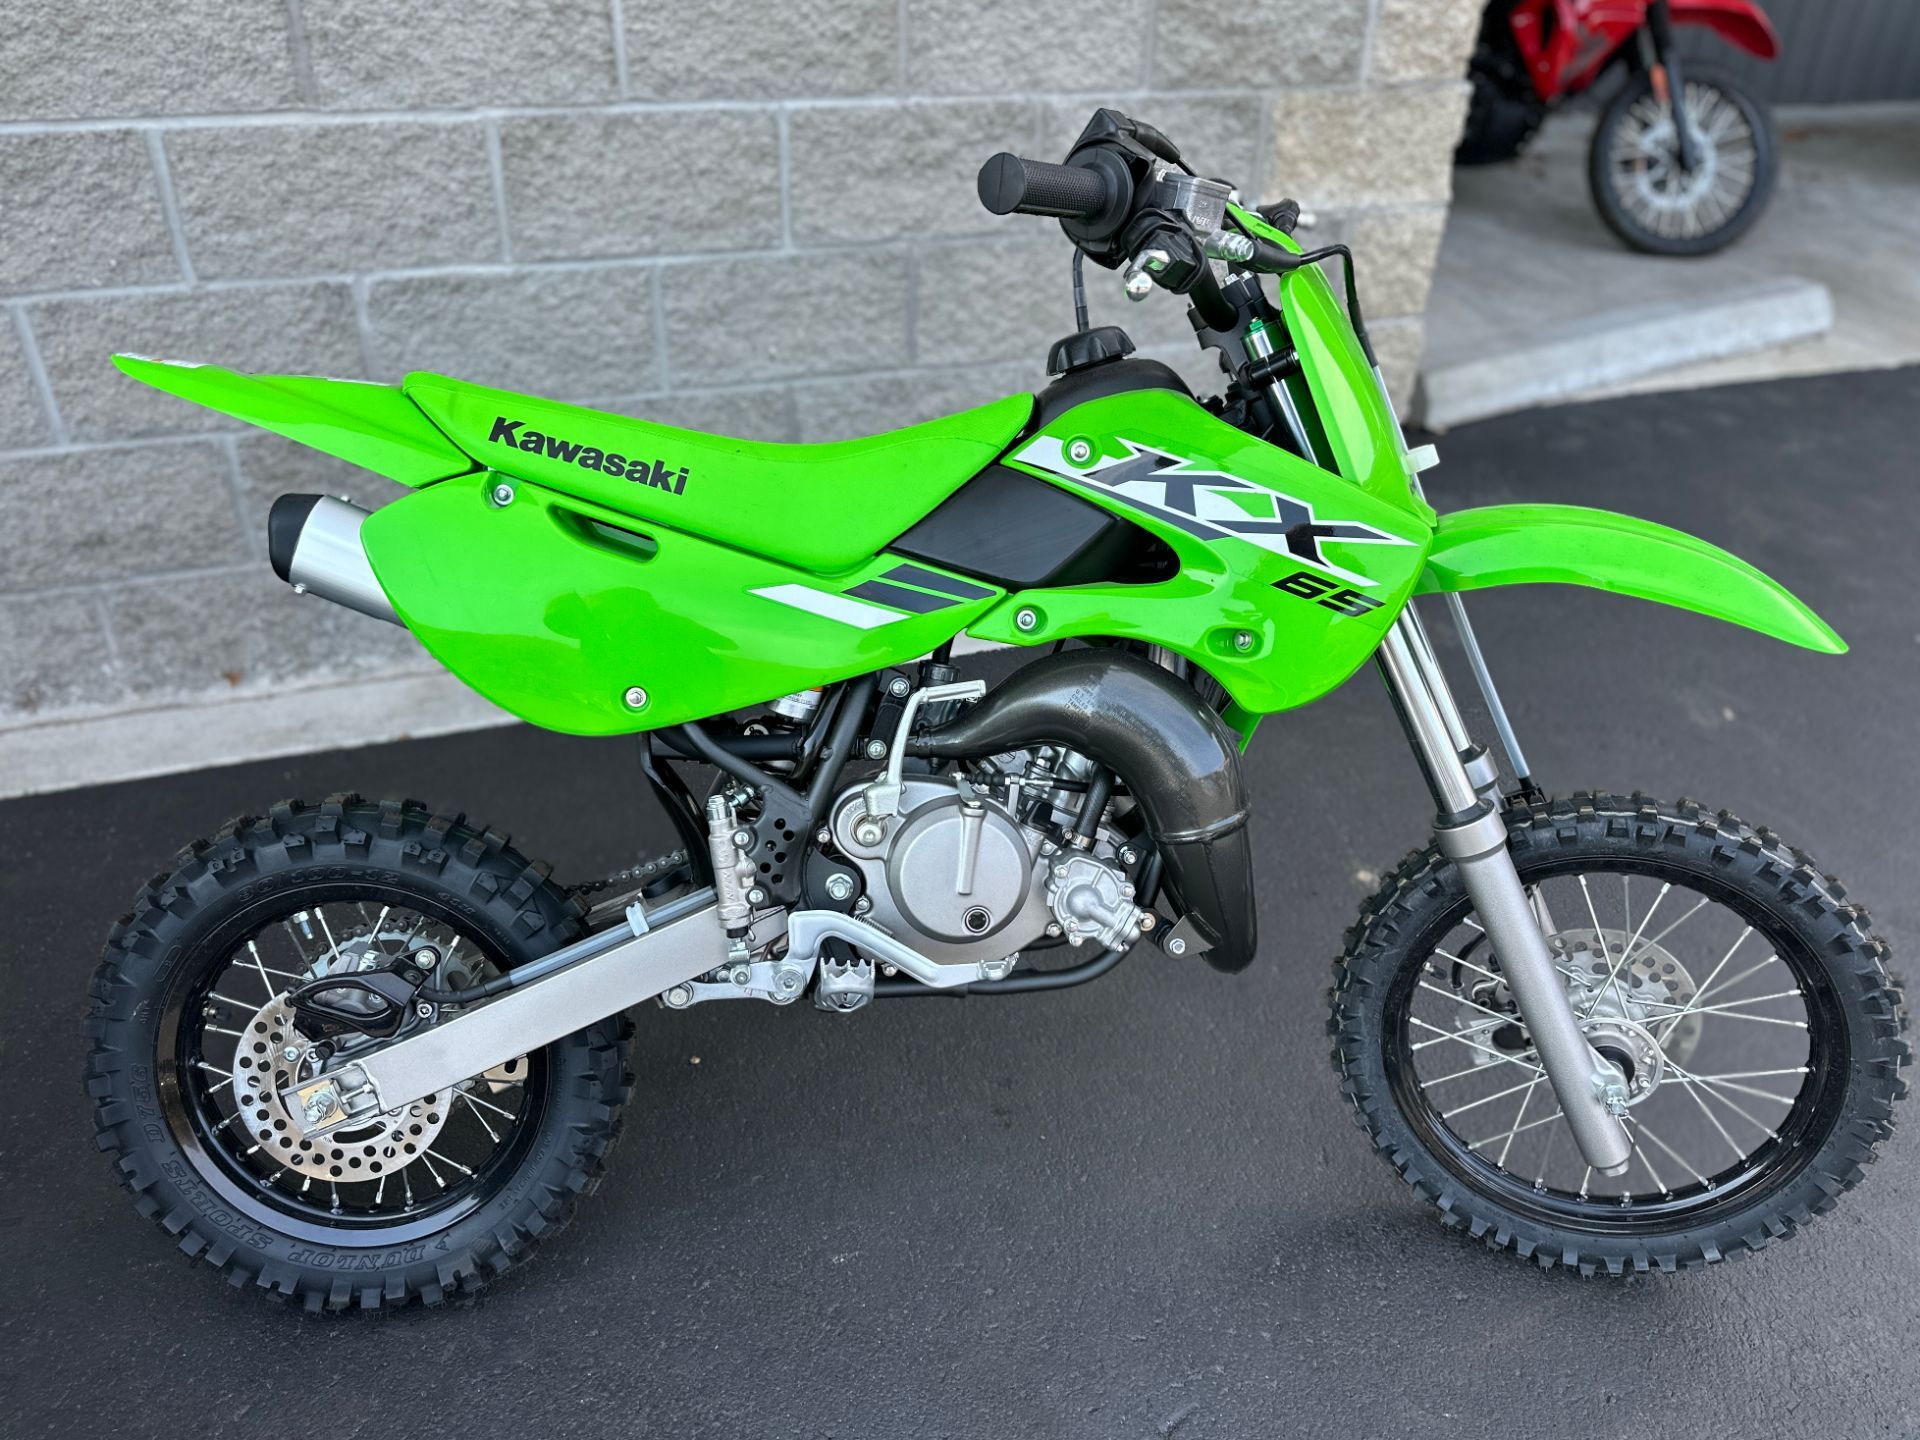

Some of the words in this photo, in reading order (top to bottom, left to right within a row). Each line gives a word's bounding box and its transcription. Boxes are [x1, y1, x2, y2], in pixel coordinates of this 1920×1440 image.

[488, 416, 690, 496] Kawasaki
[1082, 438, 1408, 575] KX
[1270, 570, 1387, 617] 65
[129, 1062, 166, 1144] D756
[161, 1159, 274, 1250] SPORTS
[288, 1243, 427, 1271] DUNLOP
